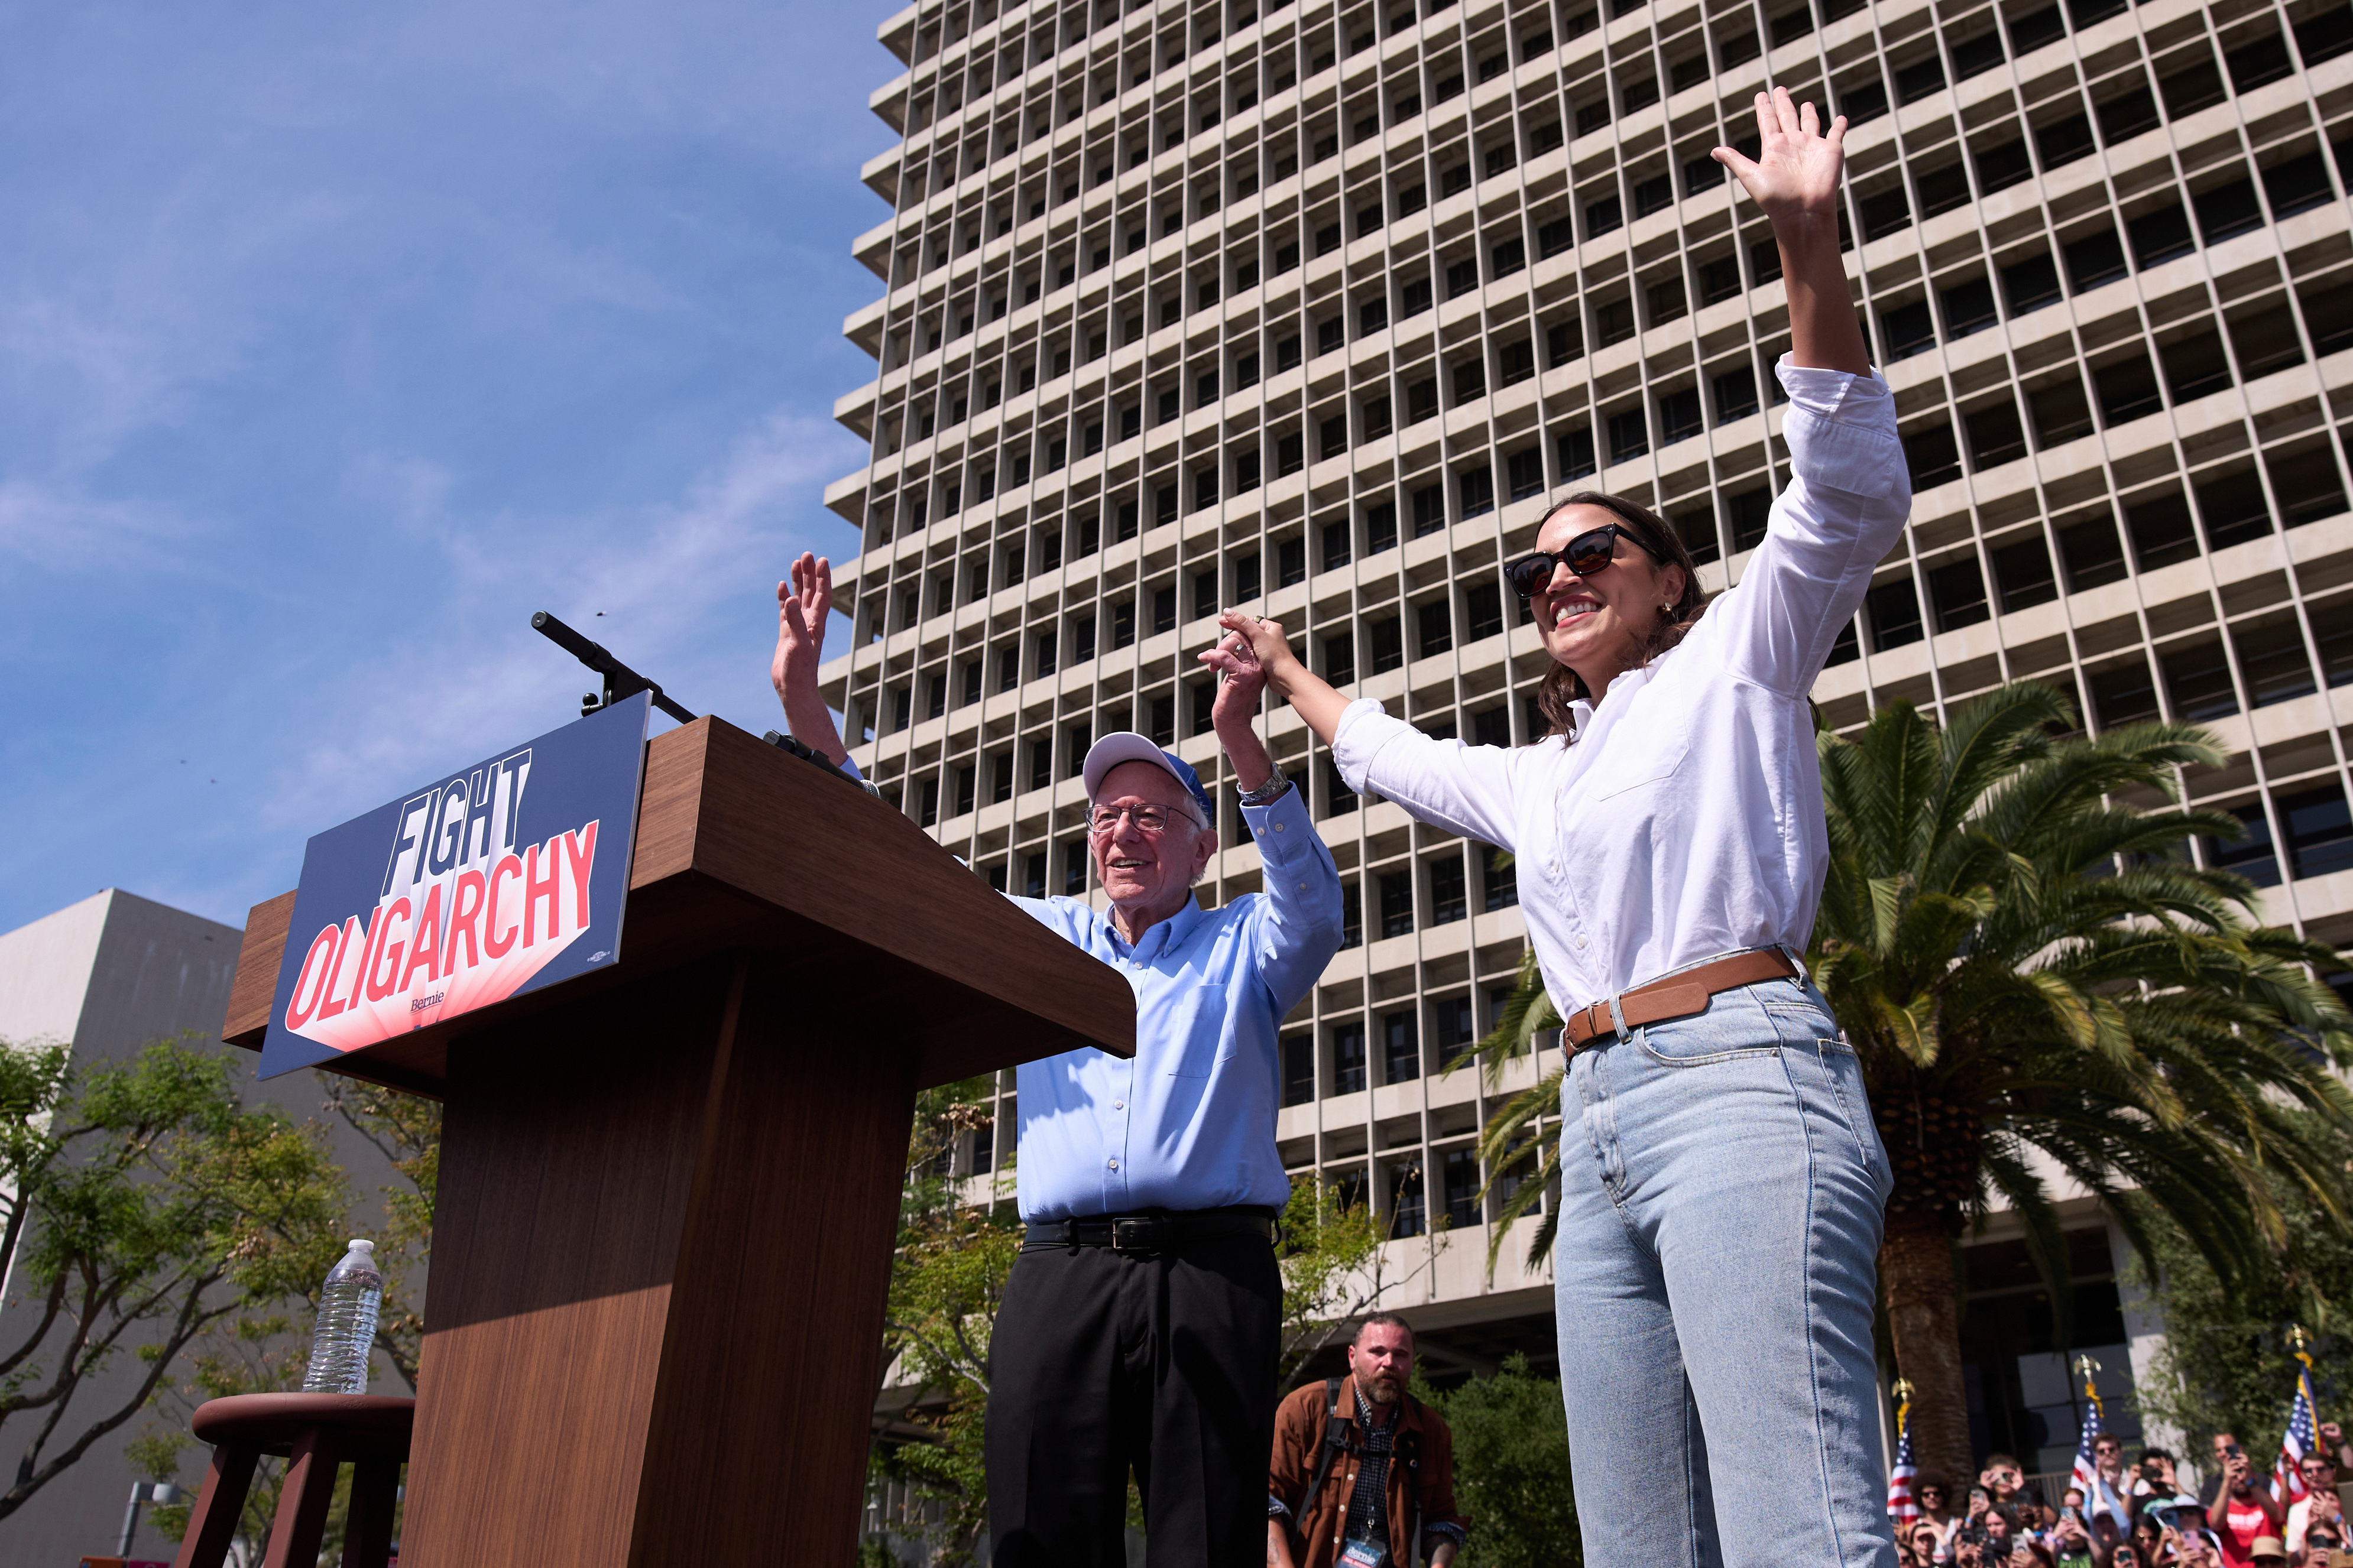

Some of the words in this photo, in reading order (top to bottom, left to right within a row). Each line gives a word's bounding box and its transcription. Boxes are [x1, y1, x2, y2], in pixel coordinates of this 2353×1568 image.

[380, 748, 532, 898] FIGHT
[285, 819, 599, 1031] OLIGARCHY
[410, 991, 444, 1012] Bernie
[1347, 1546, 1376, 1565] Bernie
